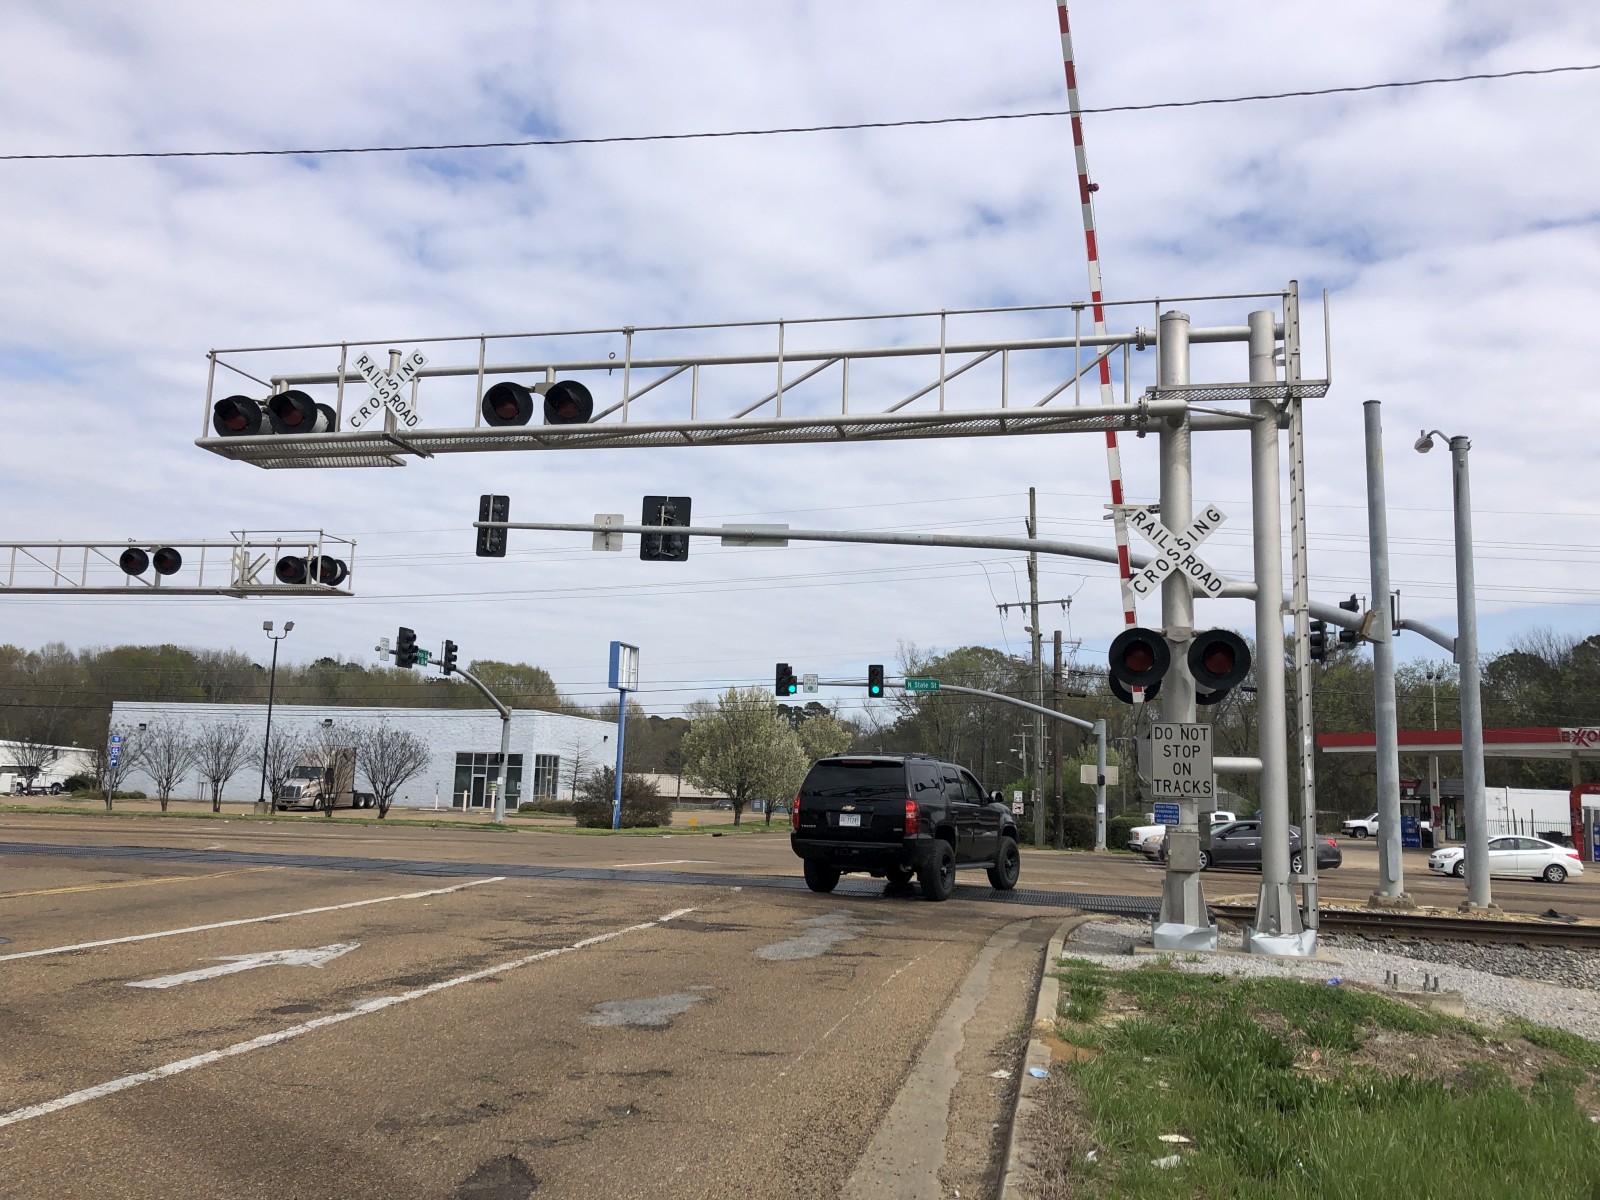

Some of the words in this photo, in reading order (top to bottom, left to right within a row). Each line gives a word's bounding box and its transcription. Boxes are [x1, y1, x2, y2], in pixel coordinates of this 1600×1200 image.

[350, 353, 424, 428] CROSSING
[1133, 509, 1220, 593] CROSSING
[1154, 727, 1173, 740] DO
[1180, 727, 1208, 741] NOT
[1561, 728, 1600, 747] EXXO
[112, 747, 118, 756] 55
[1163, 745, 1201, 758] STOP
[1173, 762, 1191, 776] ON
[1154, 779, 1211, 794] TRACKS
